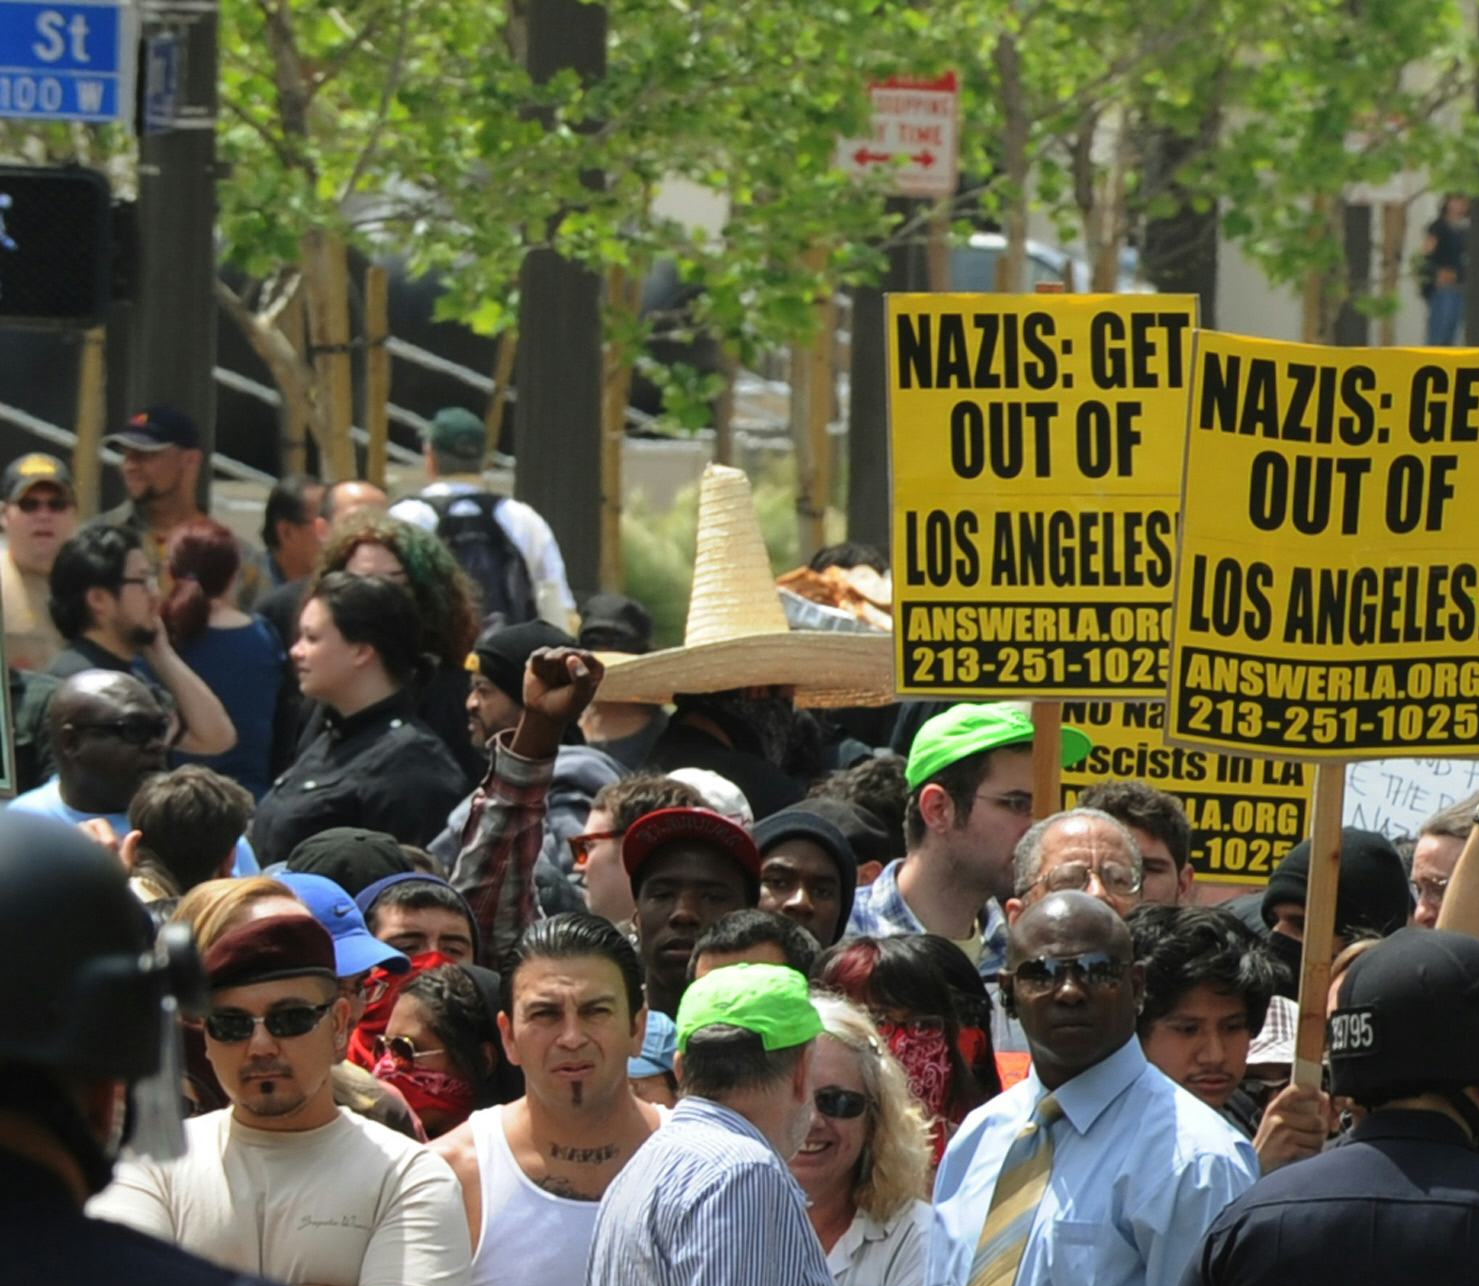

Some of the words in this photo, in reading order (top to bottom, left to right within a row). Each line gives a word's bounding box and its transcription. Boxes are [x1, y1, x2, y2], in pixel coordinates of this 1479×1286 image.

[33, 10, 91, 63] St
[77, 80, 104, 113] W
[897, 312, 1073, 389] NAZIS:
[1090, 311, 1189, 388] GET
[1199, 352, 1391, 445] NAZIS:
[950, 401, 1058, 479] OUT
[1076, 401, 1142, 478] OF
[1249, 451, 1371, 535] OUT
[1385, 455, 1458, 532] OF
[906, 510, 979, 587] LOS
[1190, 554, 1272, 641] LOS
[1188, 696, 1478, 742] 213-251-1025
[1064, 743, 1207, 781] scists
